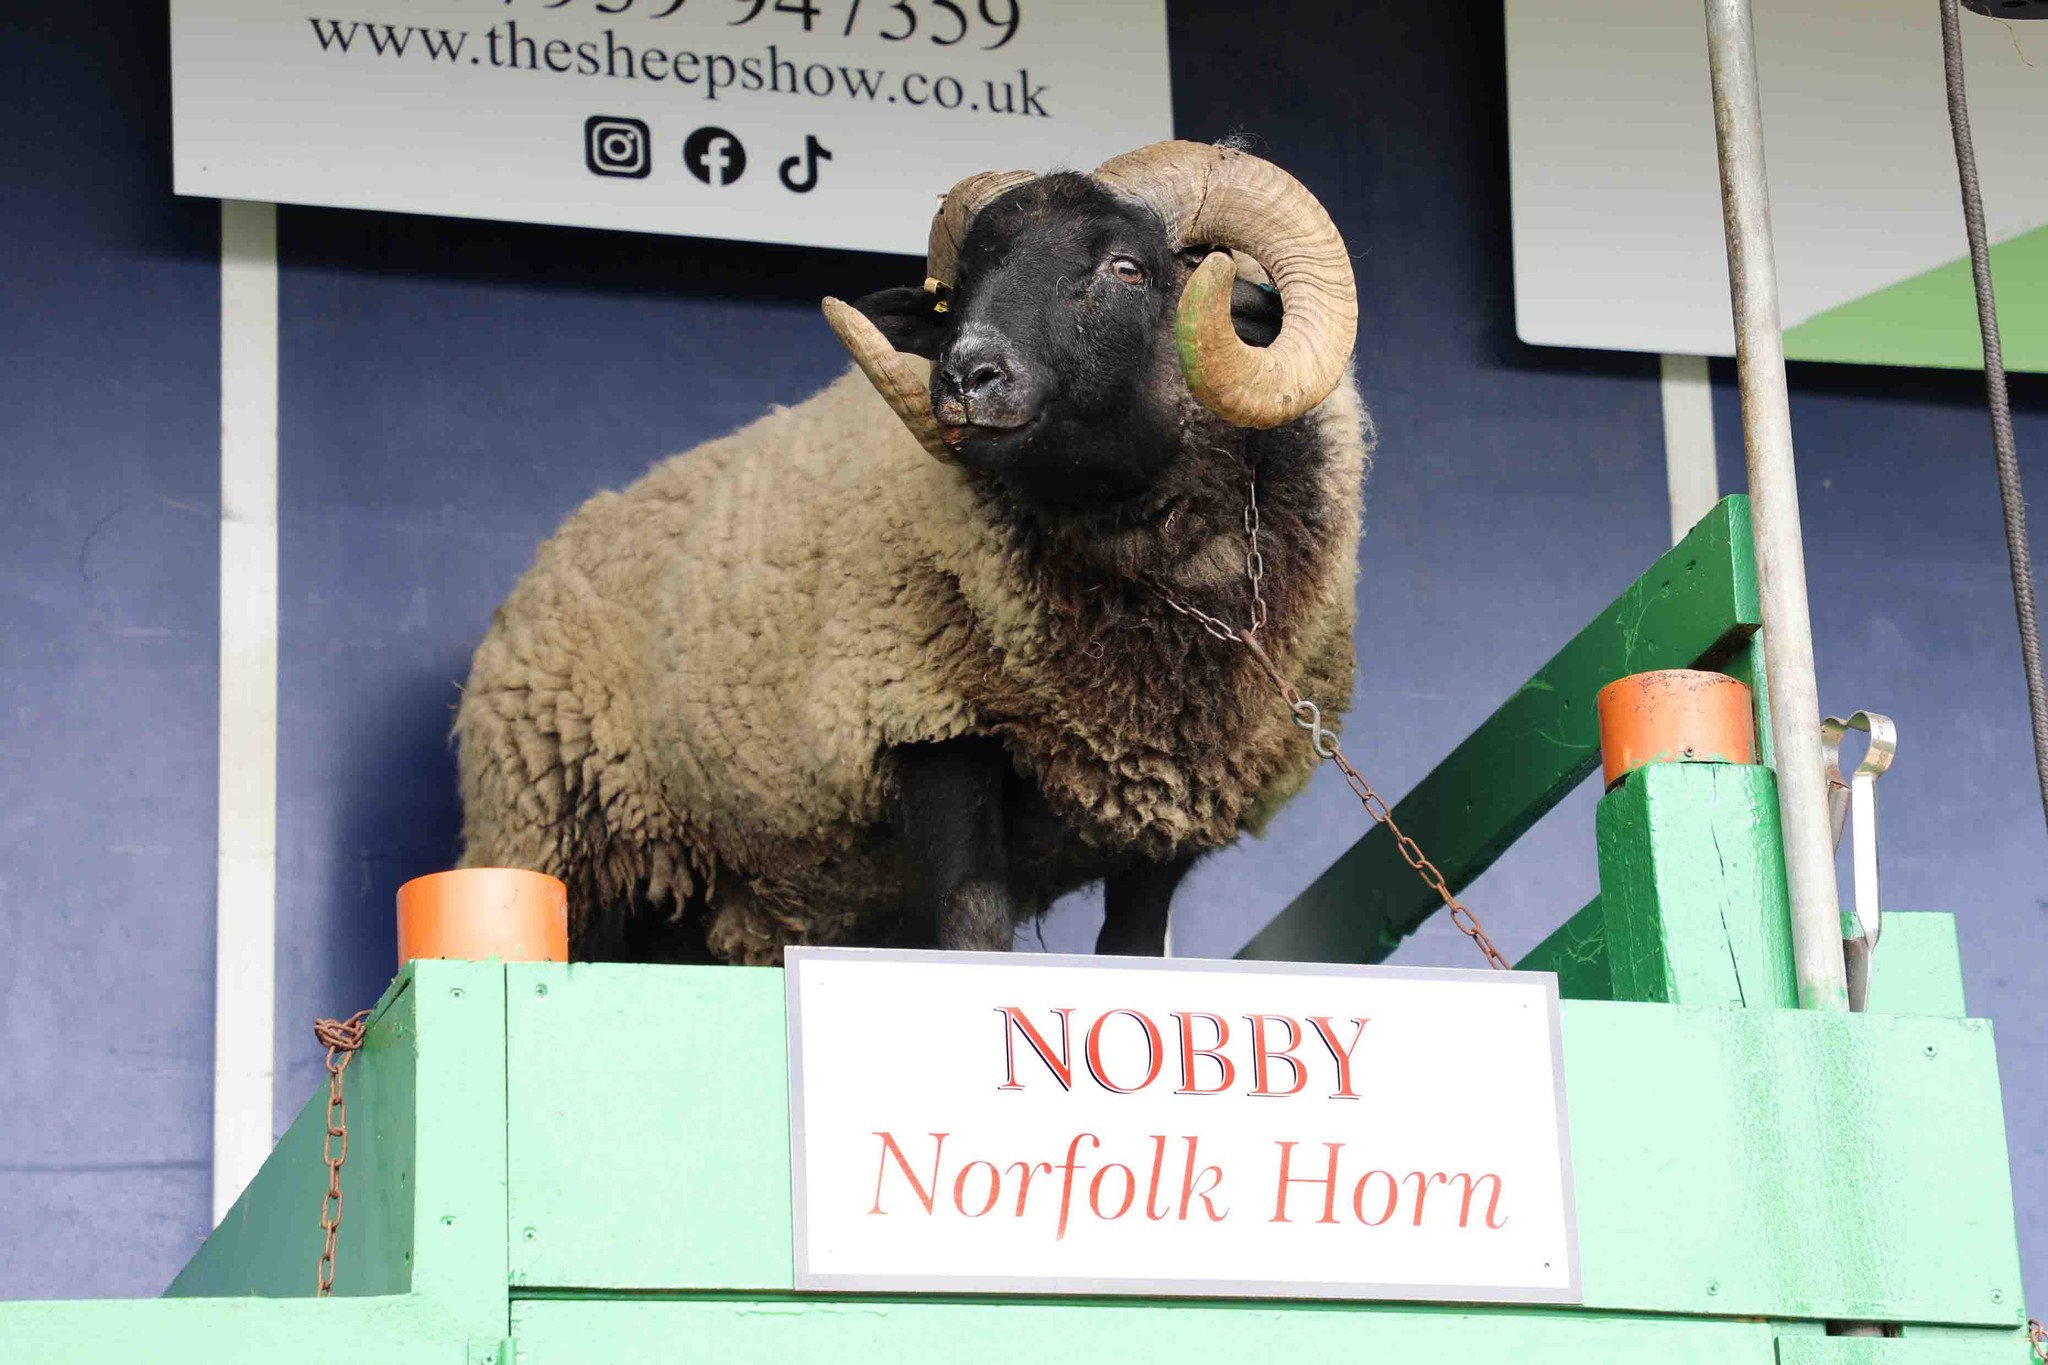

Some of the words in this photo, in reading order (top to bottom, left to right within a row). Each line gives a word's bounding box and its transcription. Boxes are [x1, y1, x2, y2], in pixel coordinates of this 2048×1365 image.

[309, 18, 1052, 118] www.thesheepshow.co.uk
[994, 1006, 1371, 1101] NOBBY
[867, 1131, 1229, 1240] Norfolk
[1269, 1141, 1509, 1231] Horn
